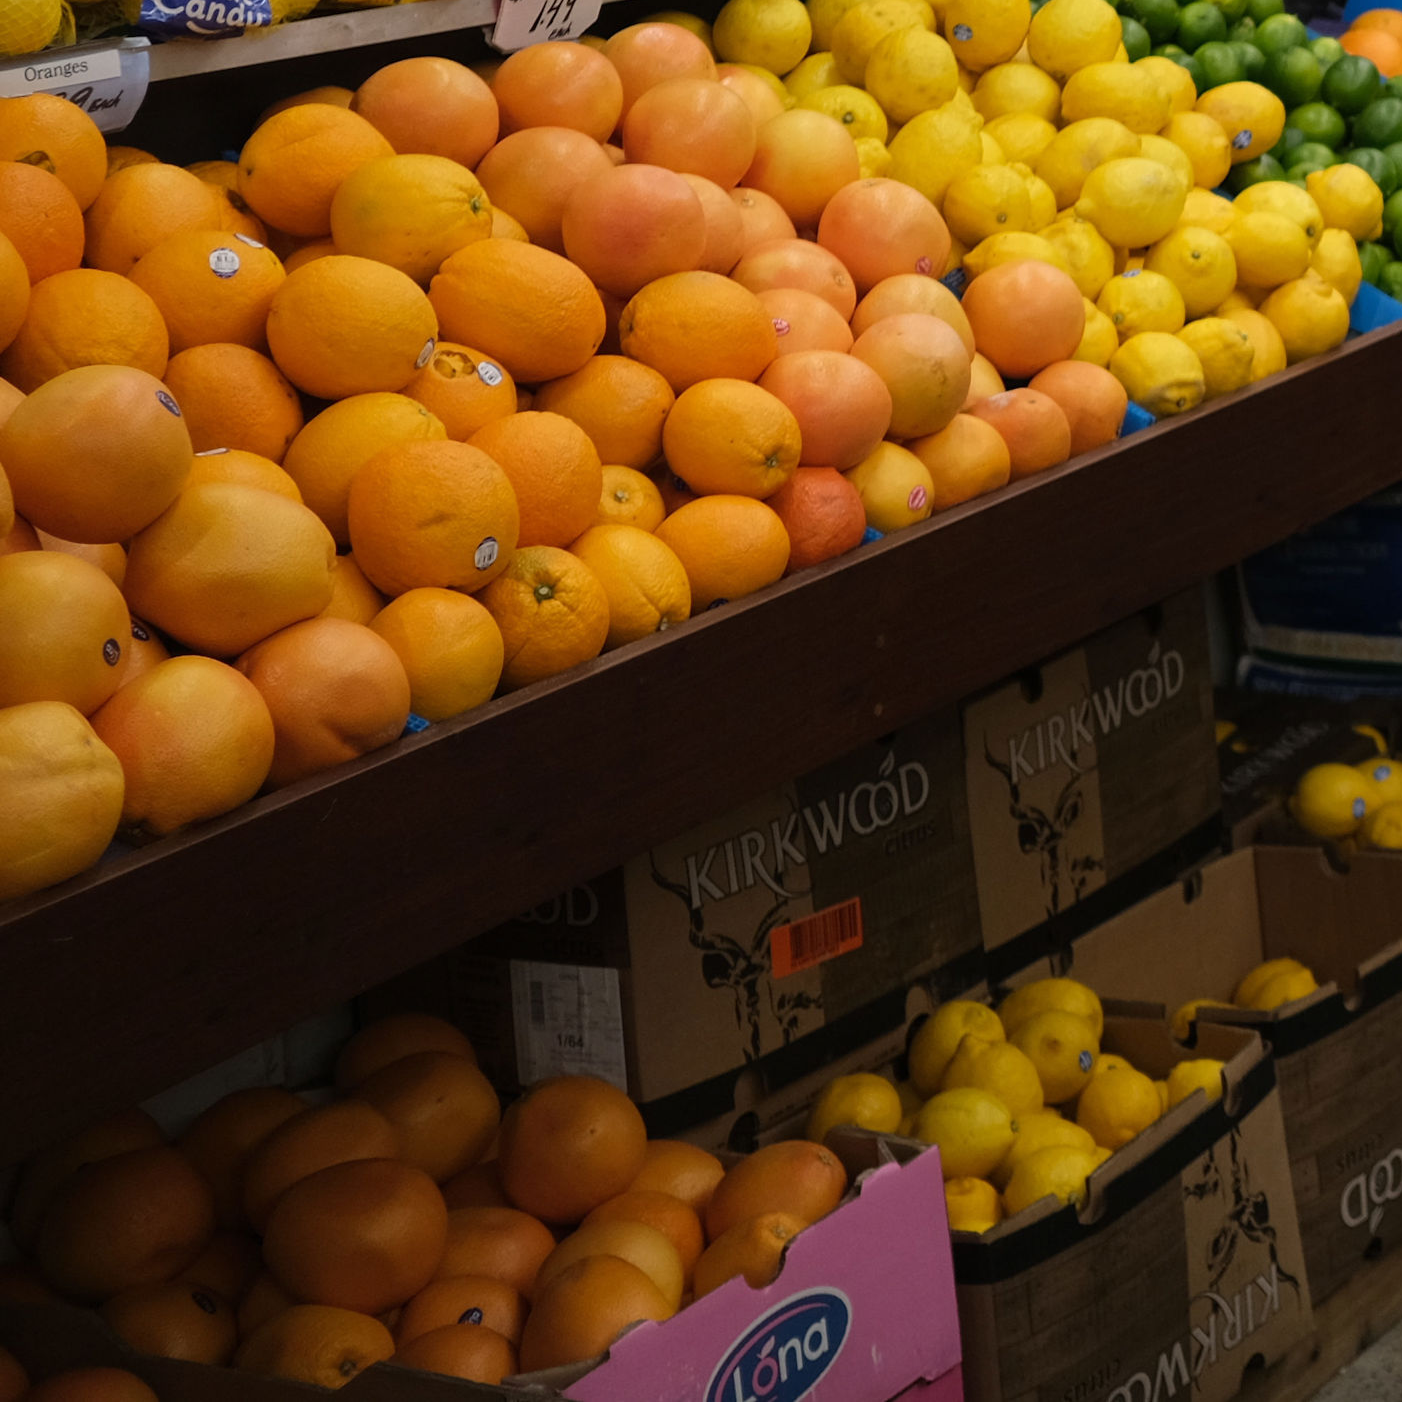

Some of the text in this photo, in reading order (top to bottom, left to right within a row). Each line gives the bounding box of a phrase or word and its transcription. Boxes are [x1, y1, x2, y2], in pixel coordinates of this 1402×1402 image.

[24, 60, 89, 82] Oranges
[1009, 648, 1186, 783] KIRKWOOD
[686, 758, 931, 911] KIRKWOOD
